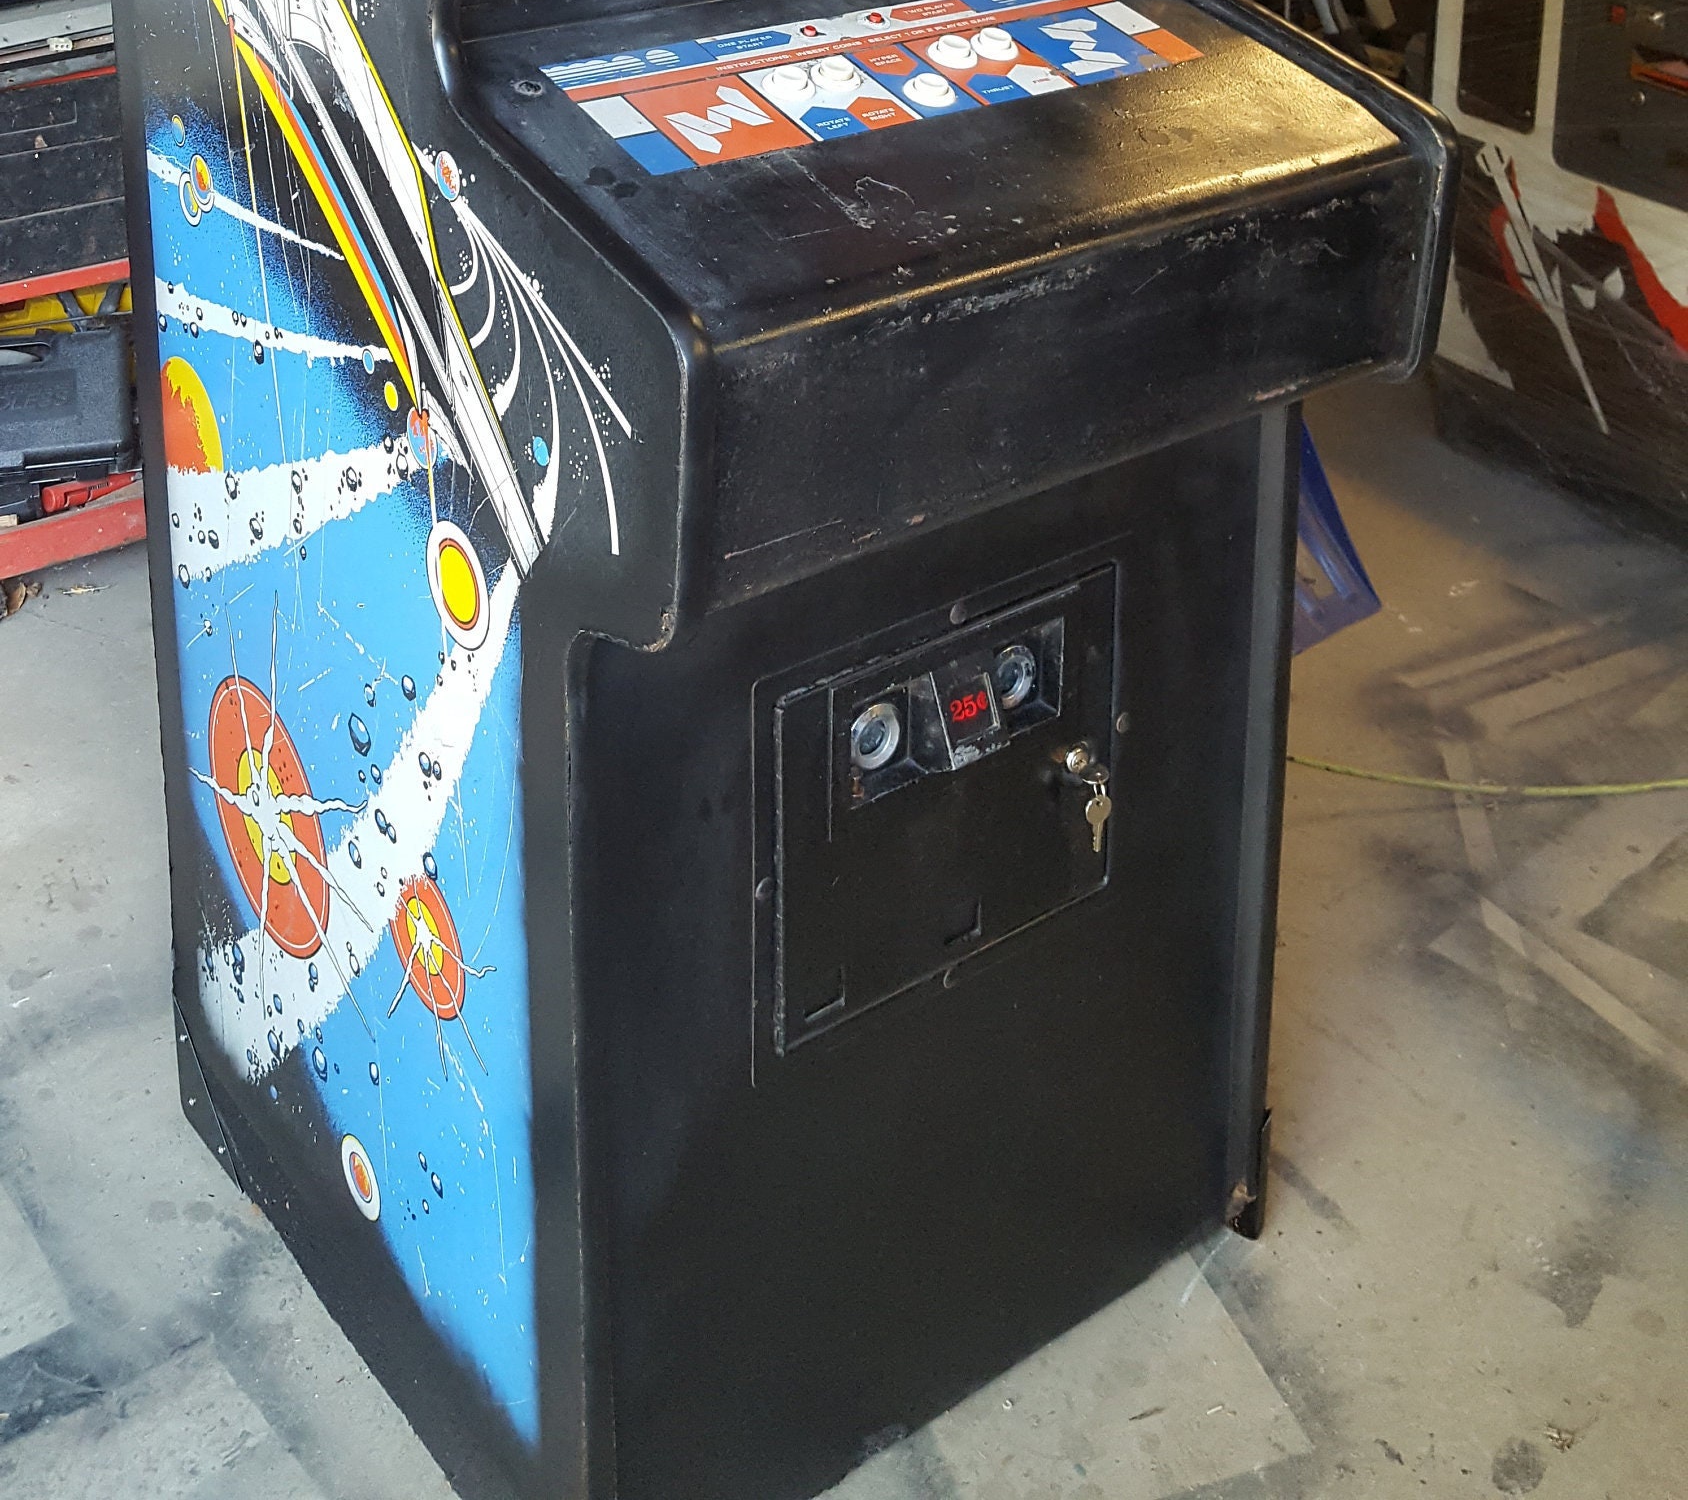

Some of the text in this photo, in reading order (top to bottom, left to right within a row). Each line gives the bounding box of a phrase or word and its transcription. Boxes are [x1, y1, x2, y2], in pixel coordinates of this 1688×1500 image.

[903, 2, 955, 16] TWO PLAYER
[921, 8, 947, 17] START
[715, 54, 792, 72] INSTRUCTIONS:
[796, 47, 831, 57] INSERT
[832, 40, 863, 50] COINS
[867, 33, 902, 43] SELECT
[911, 27, 925, 35] OR
[934, 20, 968, 31] PLAYER
[969, 15, 997, 26] GAME
[717, 34, 773, 49] ONE PLAYER
[736, 41, 764, 50] START
[869, 53, 898, 63] HYPER
[874, 57, 902, 67] SPACE
[982, 84, 1014, 95] THRUST
[861, 107, 896, 118] ROTATE
[869, 112, 896, 121] RIGHT
[816, 116, 851, 127] ROTATE
[827, 122, 849, 130] LEFT
[949, 690, 988, 723] 25¢
